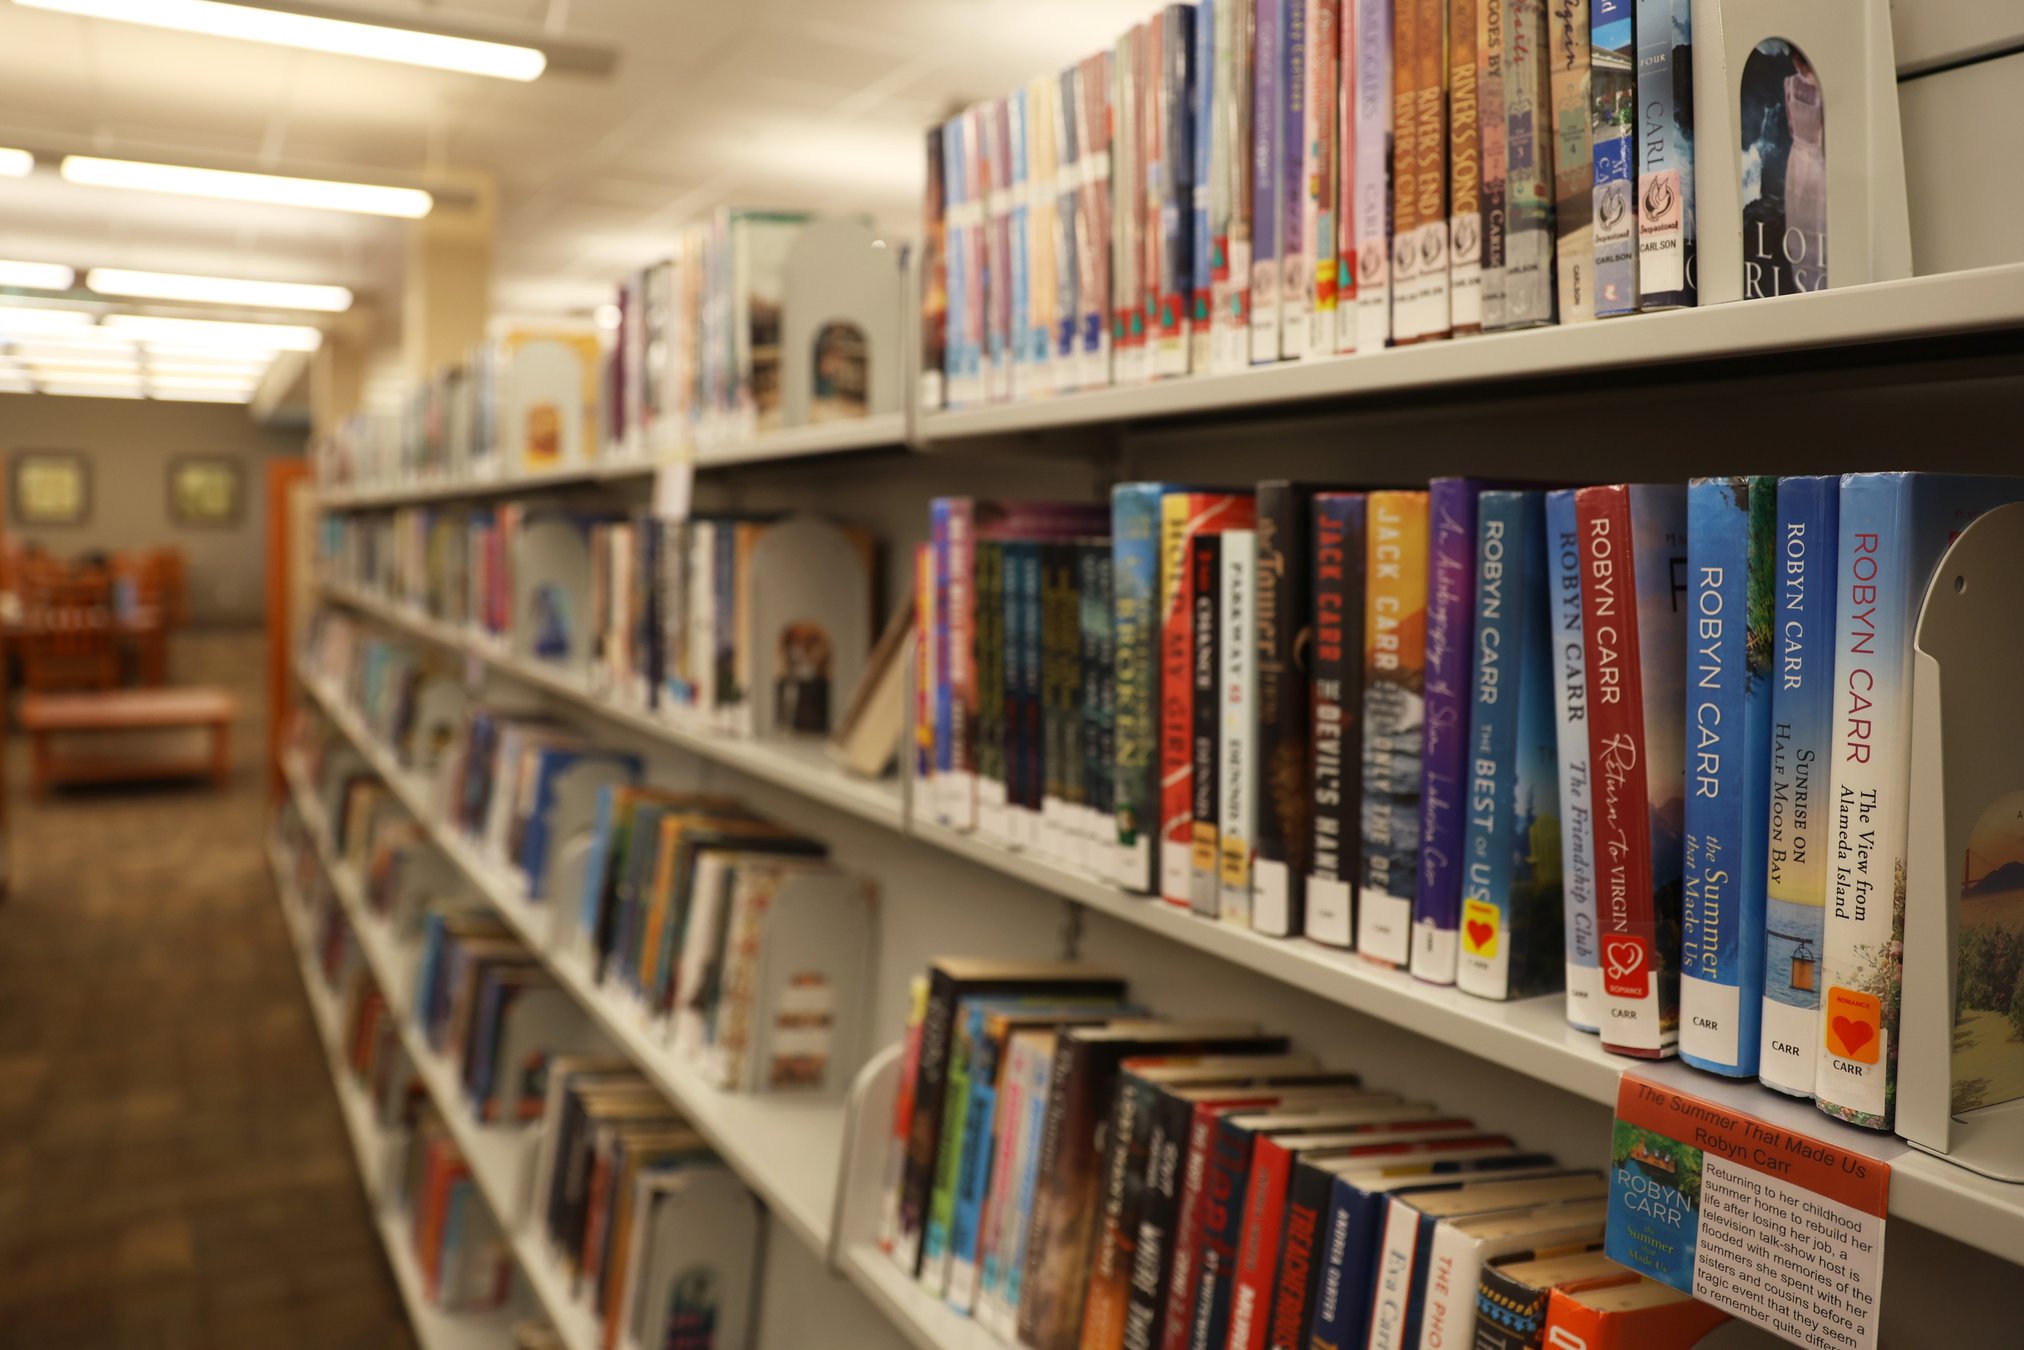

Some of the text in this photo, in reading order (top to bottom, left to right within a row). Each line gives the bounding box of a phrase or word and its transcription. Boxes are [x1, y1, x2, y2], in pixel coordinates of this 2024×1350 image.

[1640, 53, 1667, 67] FOUR
[1595, 252, 1633, 266] CARLSON
[1640, 239, 1677, 253] CARLSON
[1375, 507, 1402, 580] JACK
[1317, 514, 1344, 662] JACK CARR
[1478, 520, 1505, 705] ROBYN CARR
[1590, 518, 1621, 705] ROBYN CARR
[1784, 522, 1806, 691] ROBYN CARR
[1374, 596, 1400, 670] CARR
[1560, 531, 1586, 723] ROBYN CARR
[1846, 533, 1879, 764] ROBYN CARR
[1696, 567, 1723, 799] ROBYN CARR
[1472, 758, 1497, 834] BEST
[1771, 722, 1791, 885] HALF MOON BAY
[1569, 761, 1593, 957] The Friendship Club
[1793, 836, 1808, 864] ON
[1835, 784, 1855, 919] Alameda Island
[1855, 788, 1877, 922] The View from
[1610, 865, 1628, 933] VIRGIN
[1684, 834, 1700, 967] that Made Us
[1702, 834, 1729, 980] the Summer
[1611, 1008, 1637, 1020] CARR
[1692, 1016, 1718, 1031] CARR
[1771, 1040, 1800, 1057] CARR
[1832, 1059, 1863, 1077] CARR
[1638, 1083, 1866, 1179] The Summer That Made Us
[1695, 1127, 1792, 1174] Robyn Carr
[1618, 1169, 1691, 1213] ROBYN
[1624, 1191, 1682, 1229] CARR
[1704, 1193, 1848, 1260] life after losing her job, a
[1705, 1180, 1873, 1253] summer home to rebuild her
[1706, 1163, 1862, 1233] Returning to her childhood
[1435, 1256, 1453, 1297] THE
[1700, 1240, 1868, 1319] summers she spent with her
[1702, 1222, 1873, 1304] flooded with memories of the
[1703, 1209, 1860, 1283] television talk-show host is
[1696, 1282, 1840, 1350] to remember quite differ
[1697, 1267, 1857, 1349] tragic event that they seem
[1699, 1254, 1865, 1335] sisters and cousins before a
